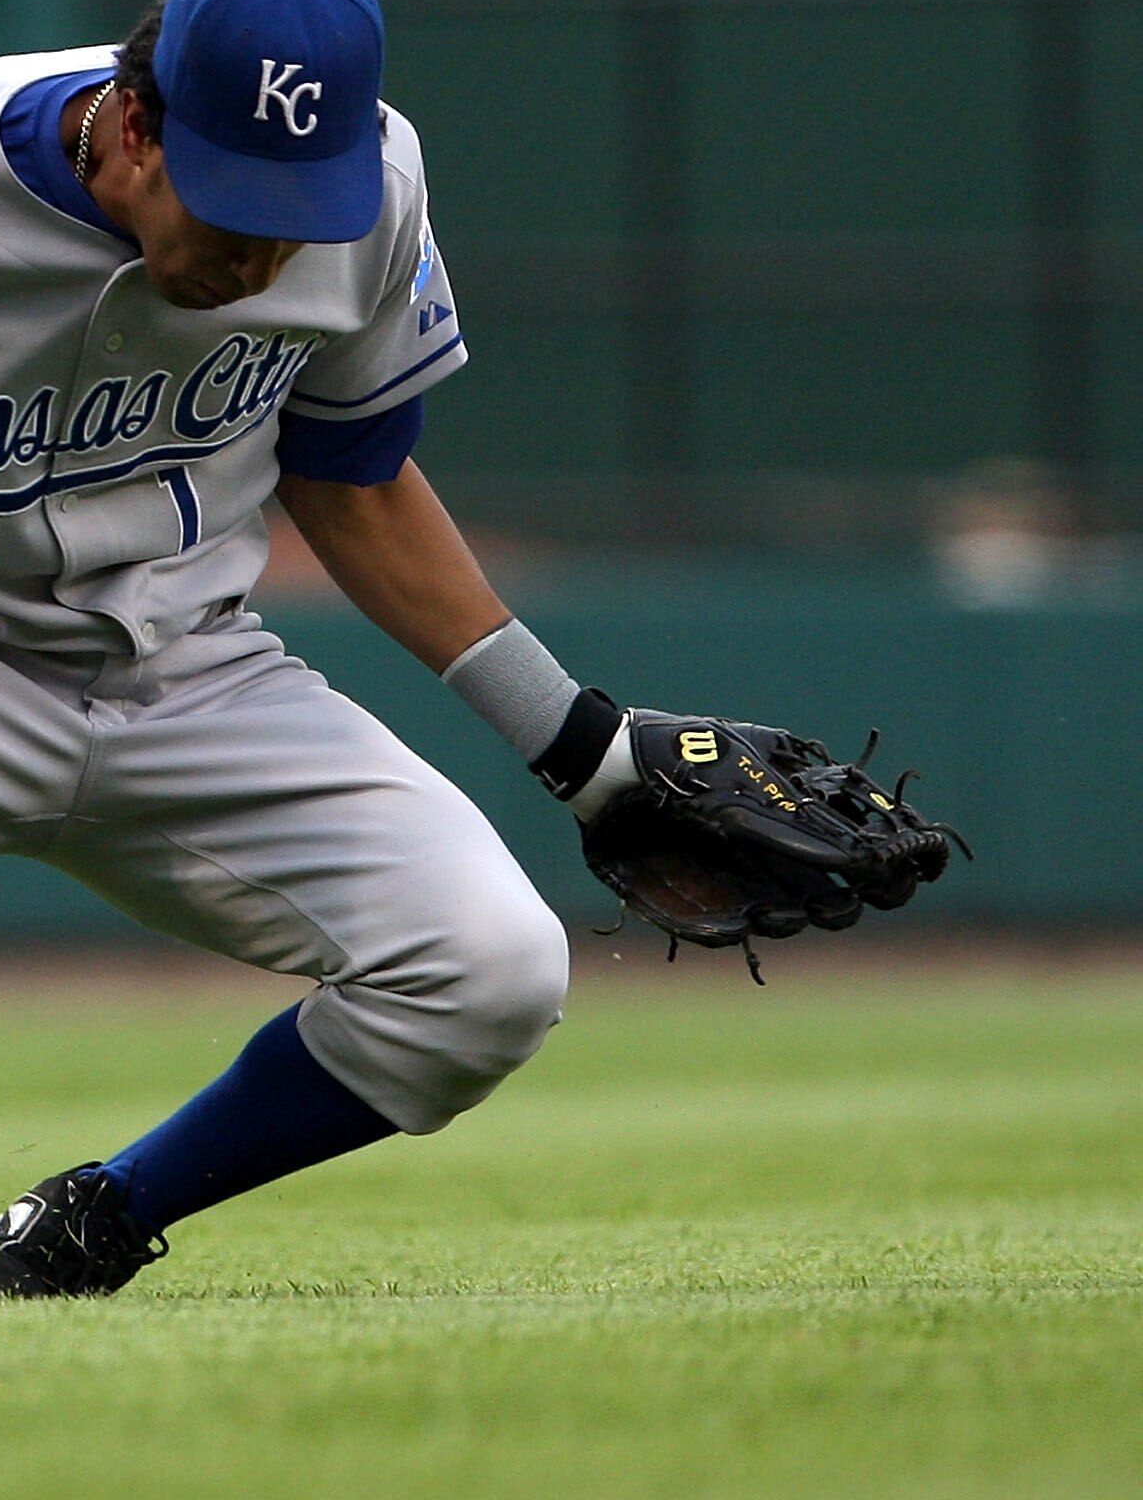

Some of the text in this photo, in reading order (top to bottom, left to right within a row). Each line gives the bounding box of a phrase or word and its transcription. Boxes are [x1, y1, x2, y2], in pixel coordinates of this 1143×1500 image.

[253, 59, 323, 137] KC
[171, 330, 320, 442] City
[158, 464, 202, 556] 1
